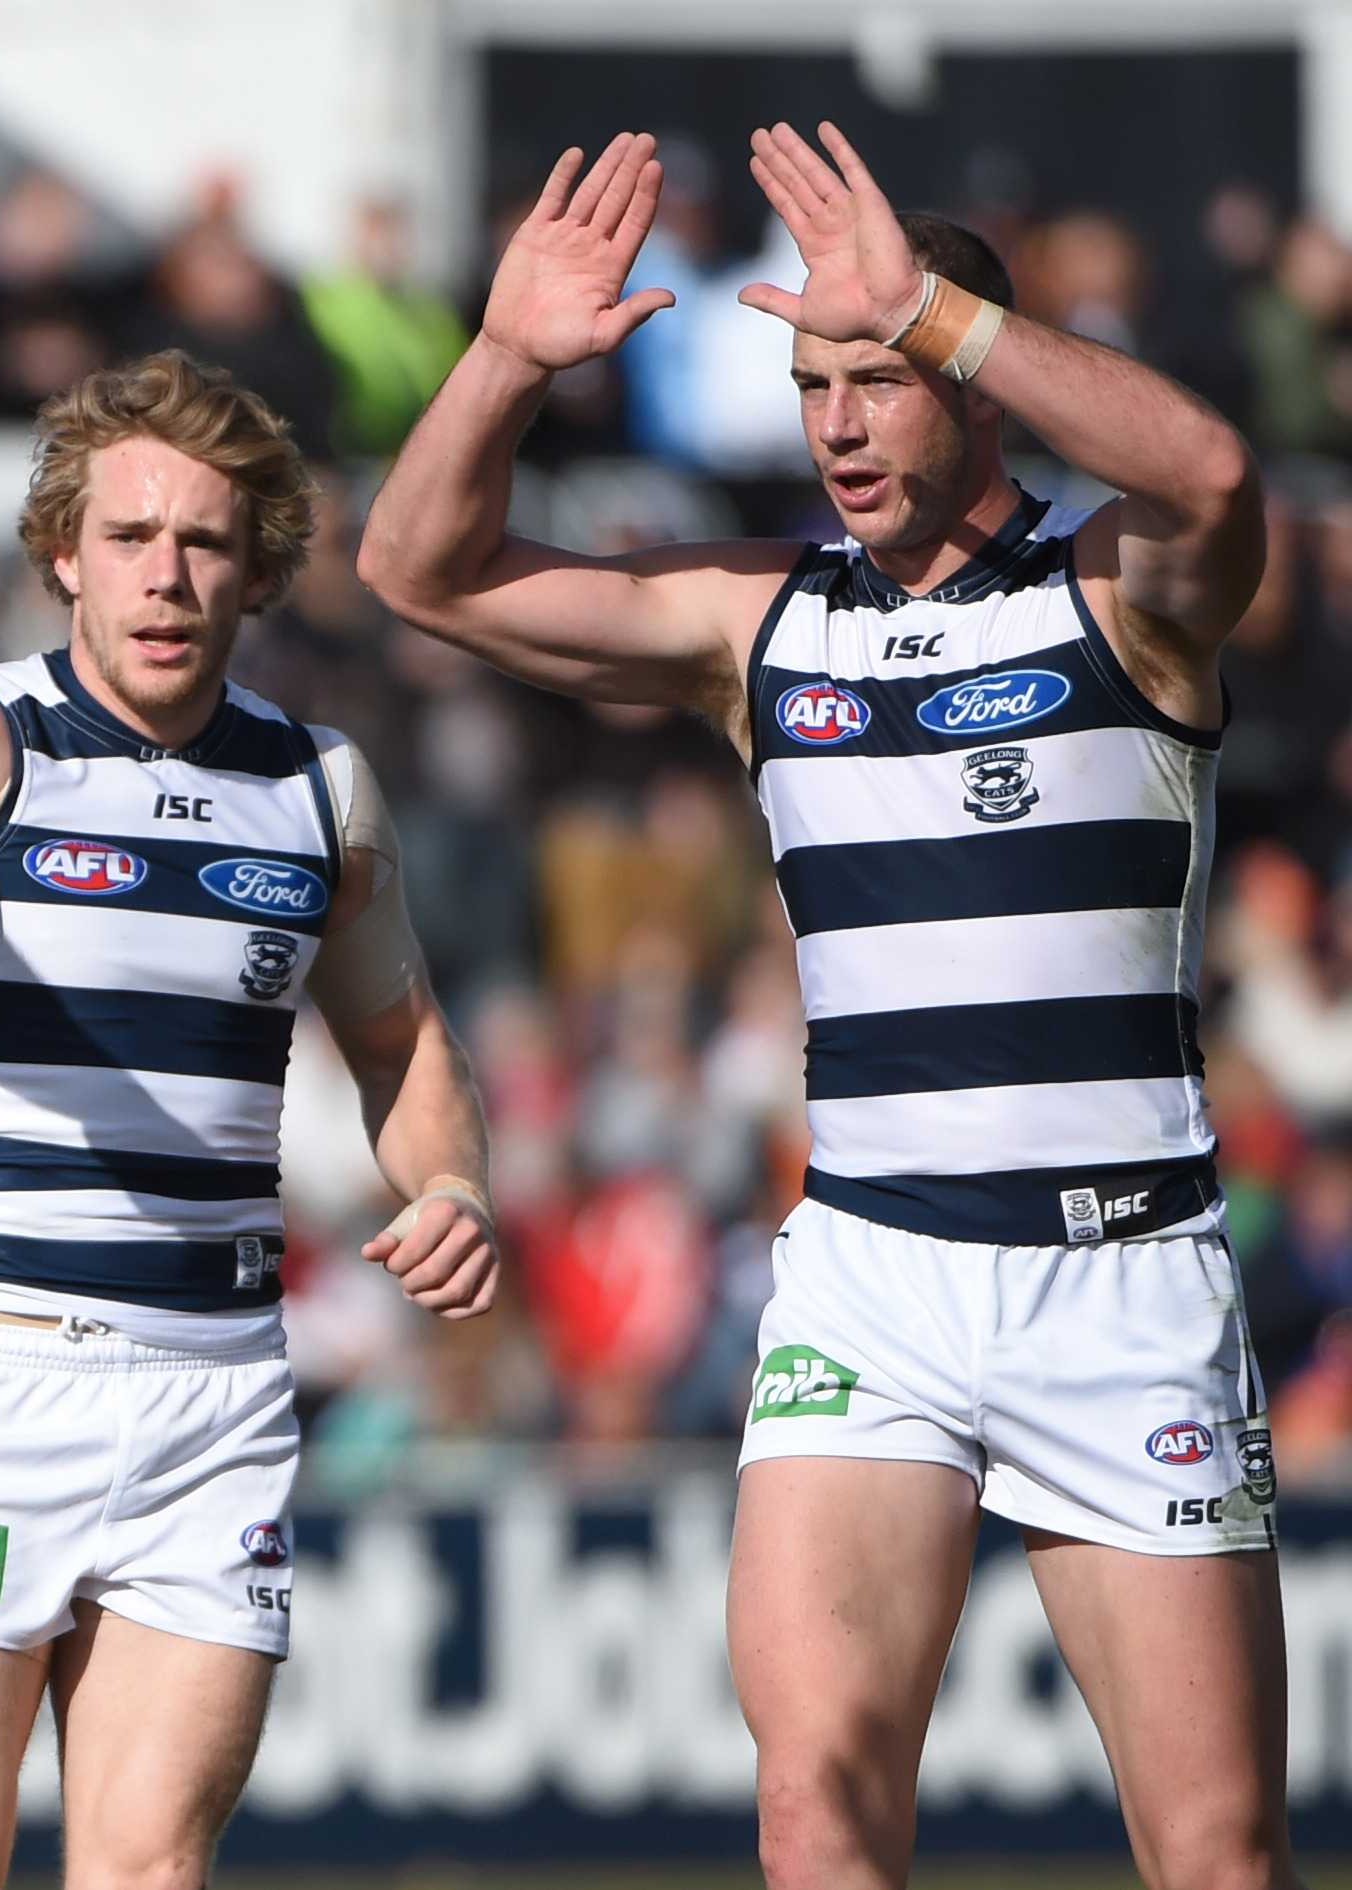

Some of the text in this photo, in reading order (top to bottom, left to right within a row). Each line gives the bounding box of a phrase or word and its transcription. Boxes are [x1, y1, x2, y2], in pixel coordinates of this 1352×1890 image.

[881, 631, 946, 661] ISC
[784, 696, 862, 730] AFL
[944, 679, 1038, 727] Ford
[968, 749, 1023, 767] GEELONG
[983, 787, 1016, 798] CATS
[153, 793, 213, 823] ISC
[34, 848, 136, 882] AFL
[228, 864, 312, 909] Ford
[1103, 1190, 1150, 1222] ISC
[755, 1358, 841, 1409] nib
[1154, 1430, 1212, 1458] AFL
[1165, 1497, 1223, 1527] ISC
[247, 1529, 287, 1556] AFL
